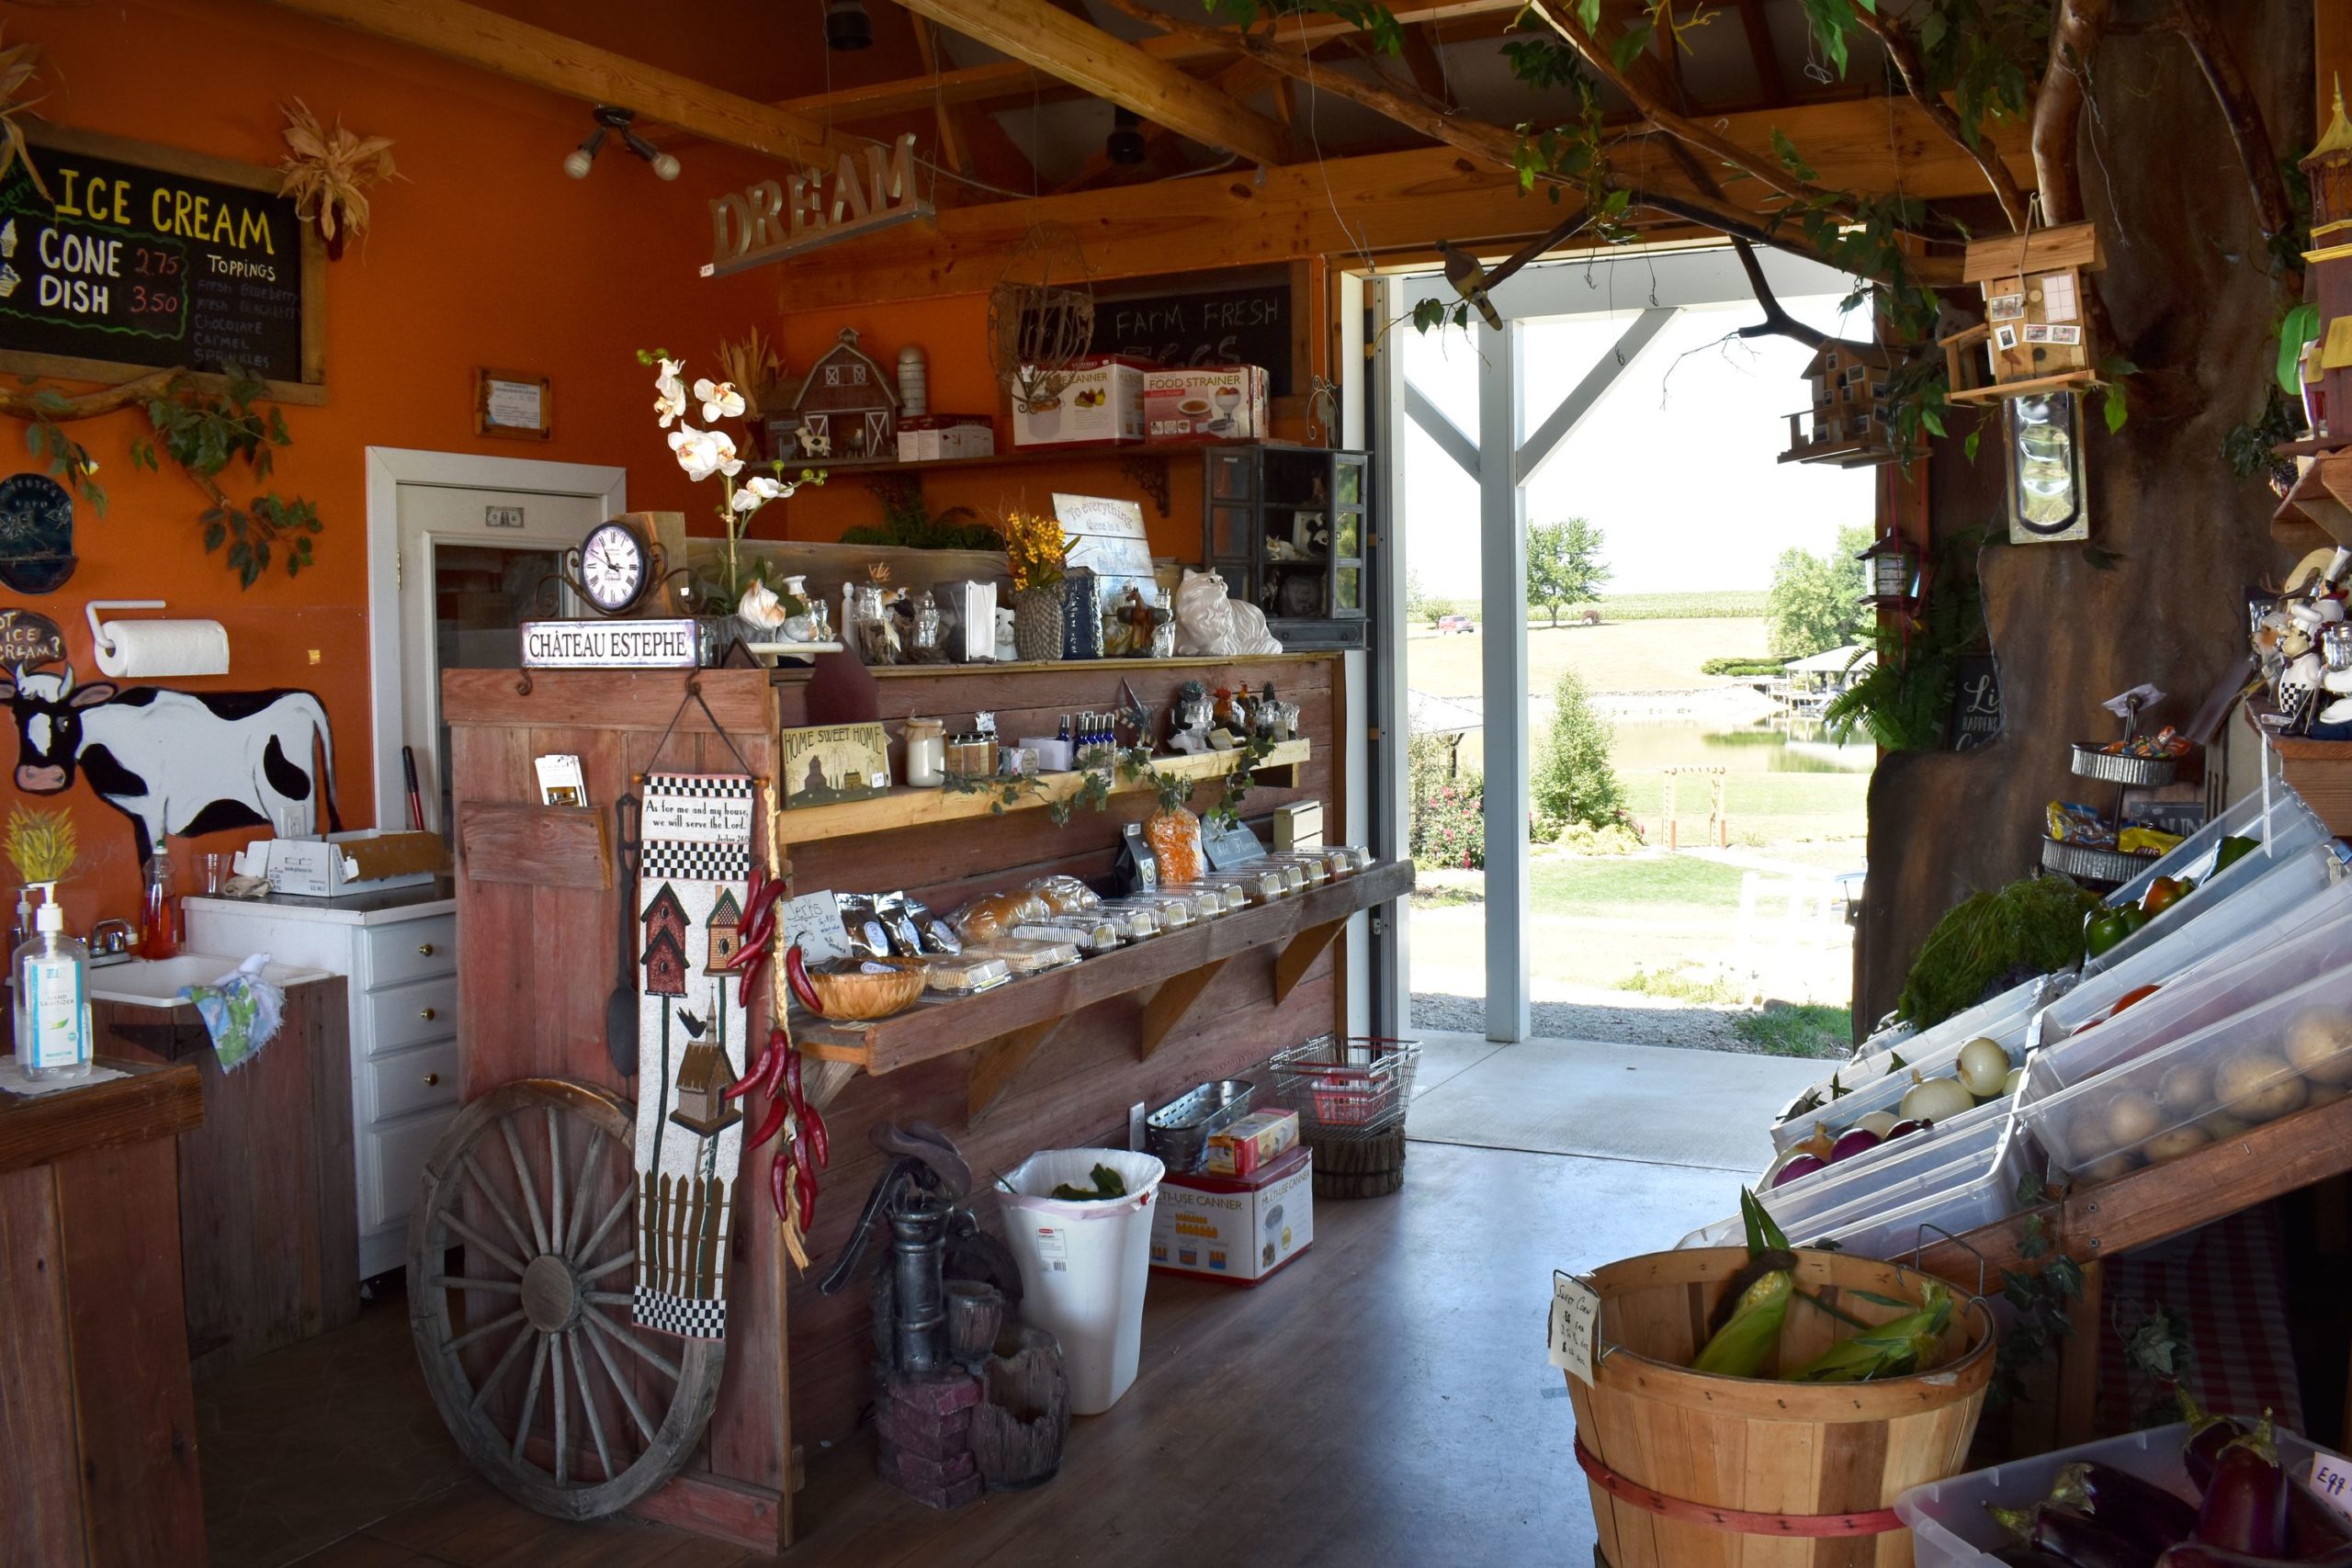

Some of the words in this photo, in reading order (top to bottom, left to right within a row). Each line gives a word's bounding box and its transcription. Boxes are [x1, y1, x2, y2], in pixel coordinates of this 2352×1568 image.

[707, 131, 917, 261] DREAM
[55, 168, 131, 225] ICE
[152, 187, 275, 255] CREAM
[40, 227, 124, 277] CONE
[134, 248, 179, 276] 2.75
[40, 275, 109, 314] DISH
[130, 286, 178, 313] 3.50
[1204, 294, 1278, 331] FRESH
[1149, 378, 1184, 389] FOOD
[1185, 375, 1241, 388] STRAINER
[1067, 506, 1081, 522] To
[1081, 502, 1133, 530] everything
[1086, 518, 1106, 531] there
[6, 627, 37, 643] ICE
[529, 629, 605, 657] CHÂTEAU
[610, 631, 687, 657] ESTEPHE
[1962, 716, 1998, 732] HAPPENS
[784, 730, 815, 764] HOME
[817, 727, 850, 743] SWEET
[853, 726, 882, 755] HOME
[646, 799, 659, 813] As
[662, 799, 673, 813] for
[692, 802, 707, 815] and
[709, 808, 722, 818] my
[668, 814, 683, 828] will
[685, 820, 707, 829] serve
[709, 816, 722, 829] the
[40, 998, 74, 1007] SANITIZER
[1288, 1169, 1311, 1193] CANNER
[1196, 1194, 1243, 1211] CANNER
[2316, 1466, 2346, 1496] Egg
